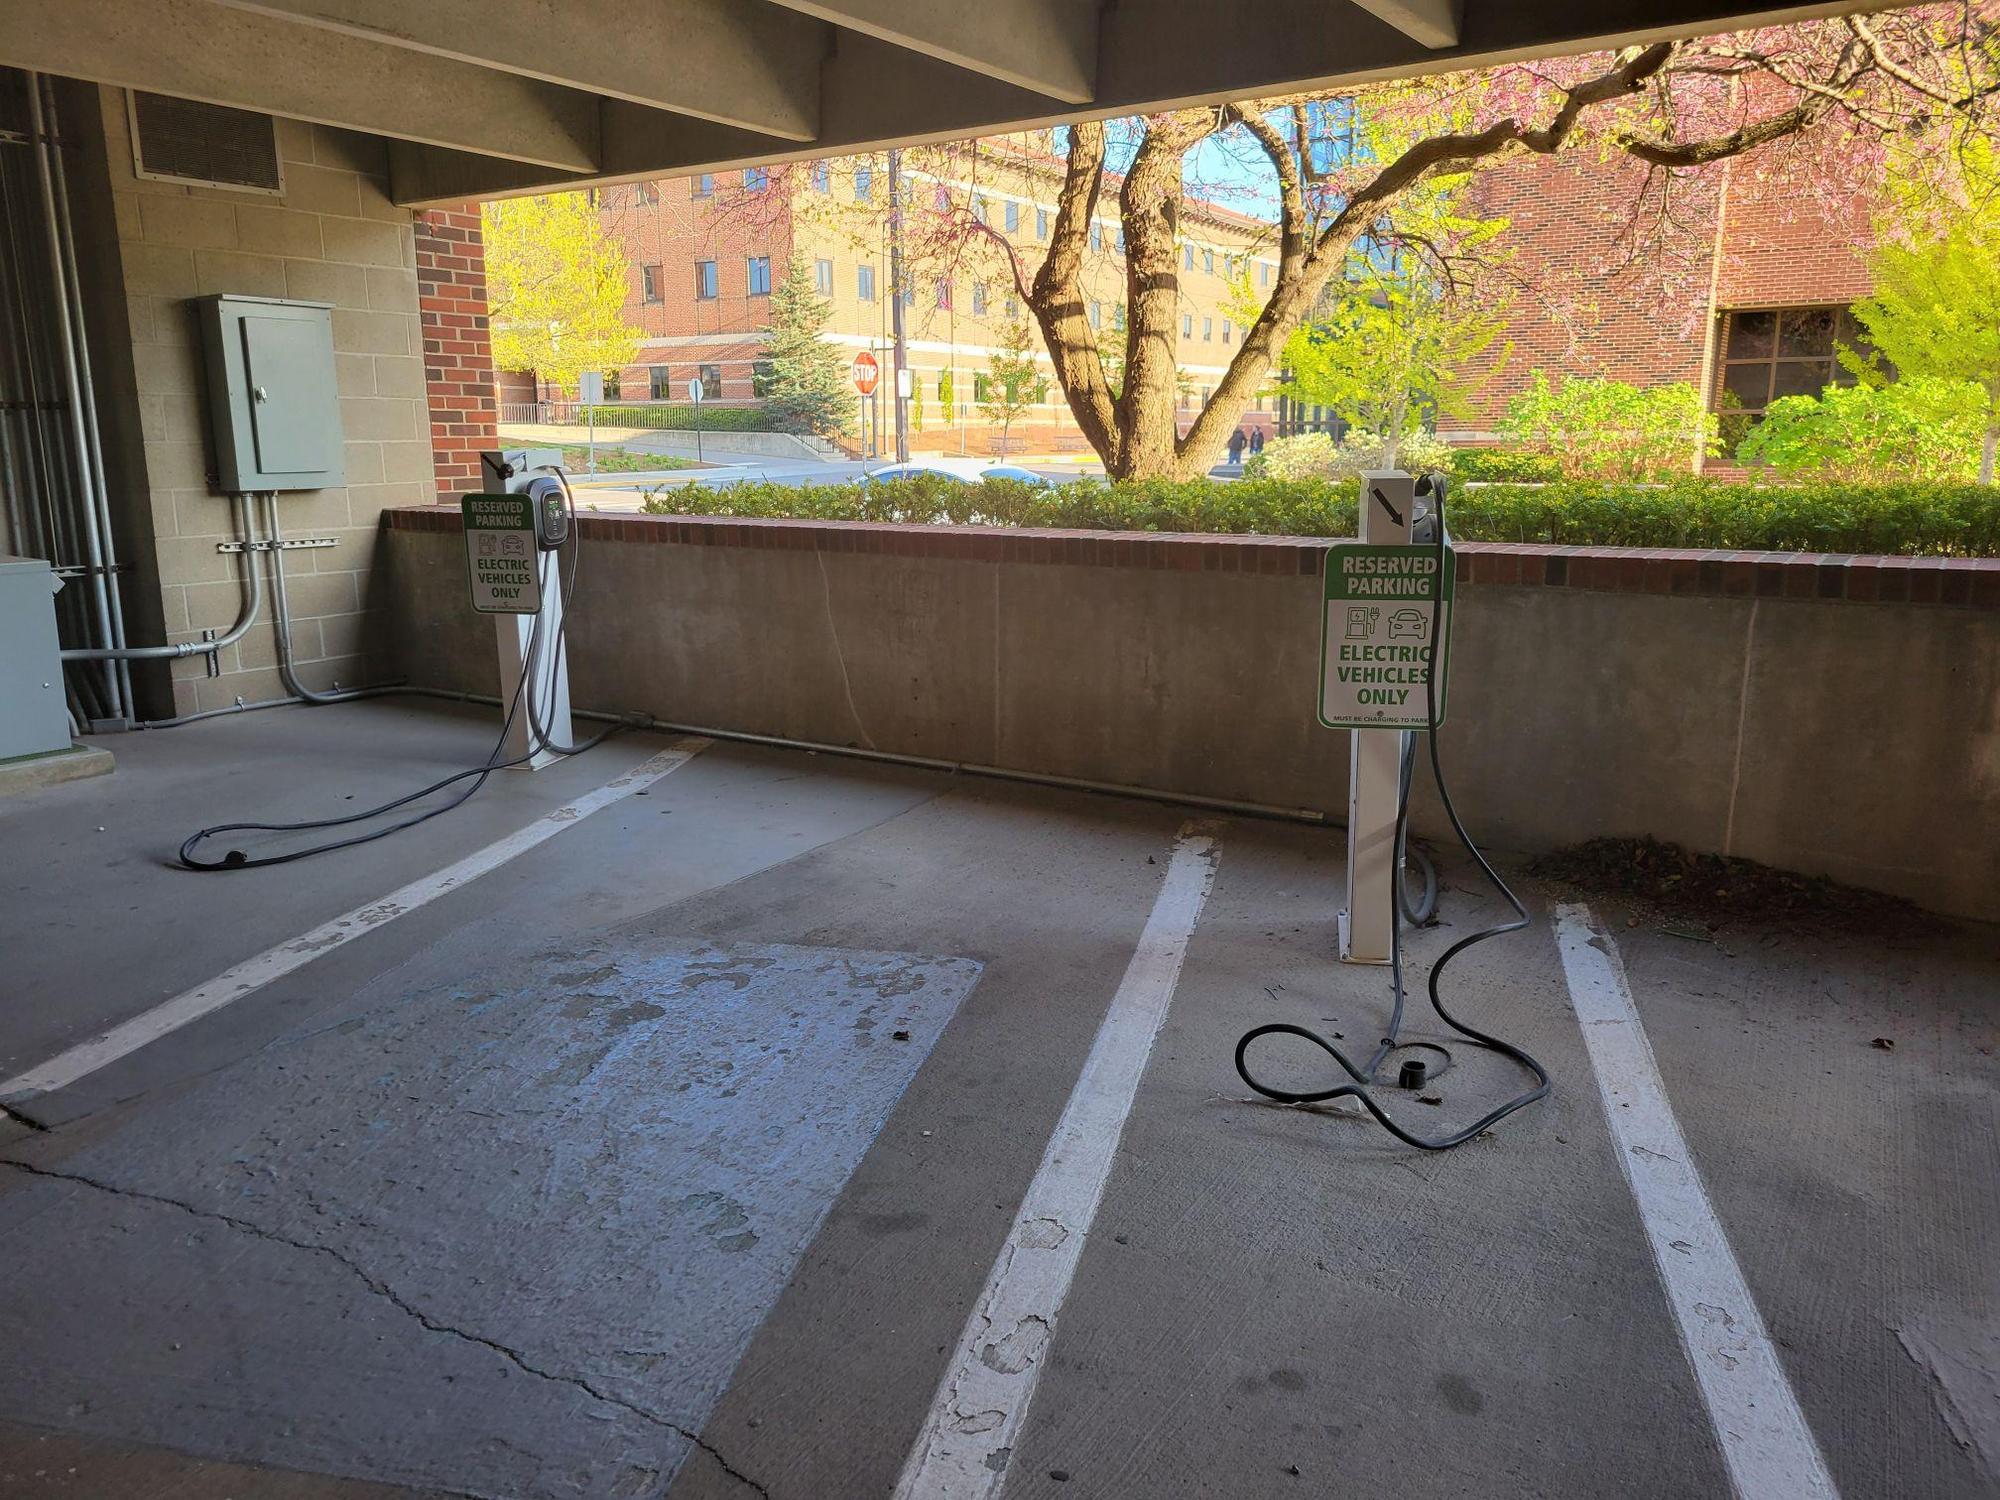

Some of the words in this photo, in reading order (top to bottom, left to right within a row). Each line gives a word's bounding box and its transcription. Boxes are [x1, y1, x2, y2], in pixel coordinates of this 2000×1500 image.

[854, 364, 876, 381] STOP
[471, 501, 524, 513] RESERVED
[476, 515, 522, 527] PARKING
[477, 559, 529, 571] ELECTRIC
[1342, 556, 1437, 574] RESERVED
[478, 573, 531, 585] VEHICLES
[1347, 578, 1430, 595] PARKING
[491, 587, 520, 599] ONLY
[1339, 645, 1431, 662] ELECTRIC
[1337, 667, 1429, 684] VEHICLES
[1357, 688, 1409, 705] ONLY
